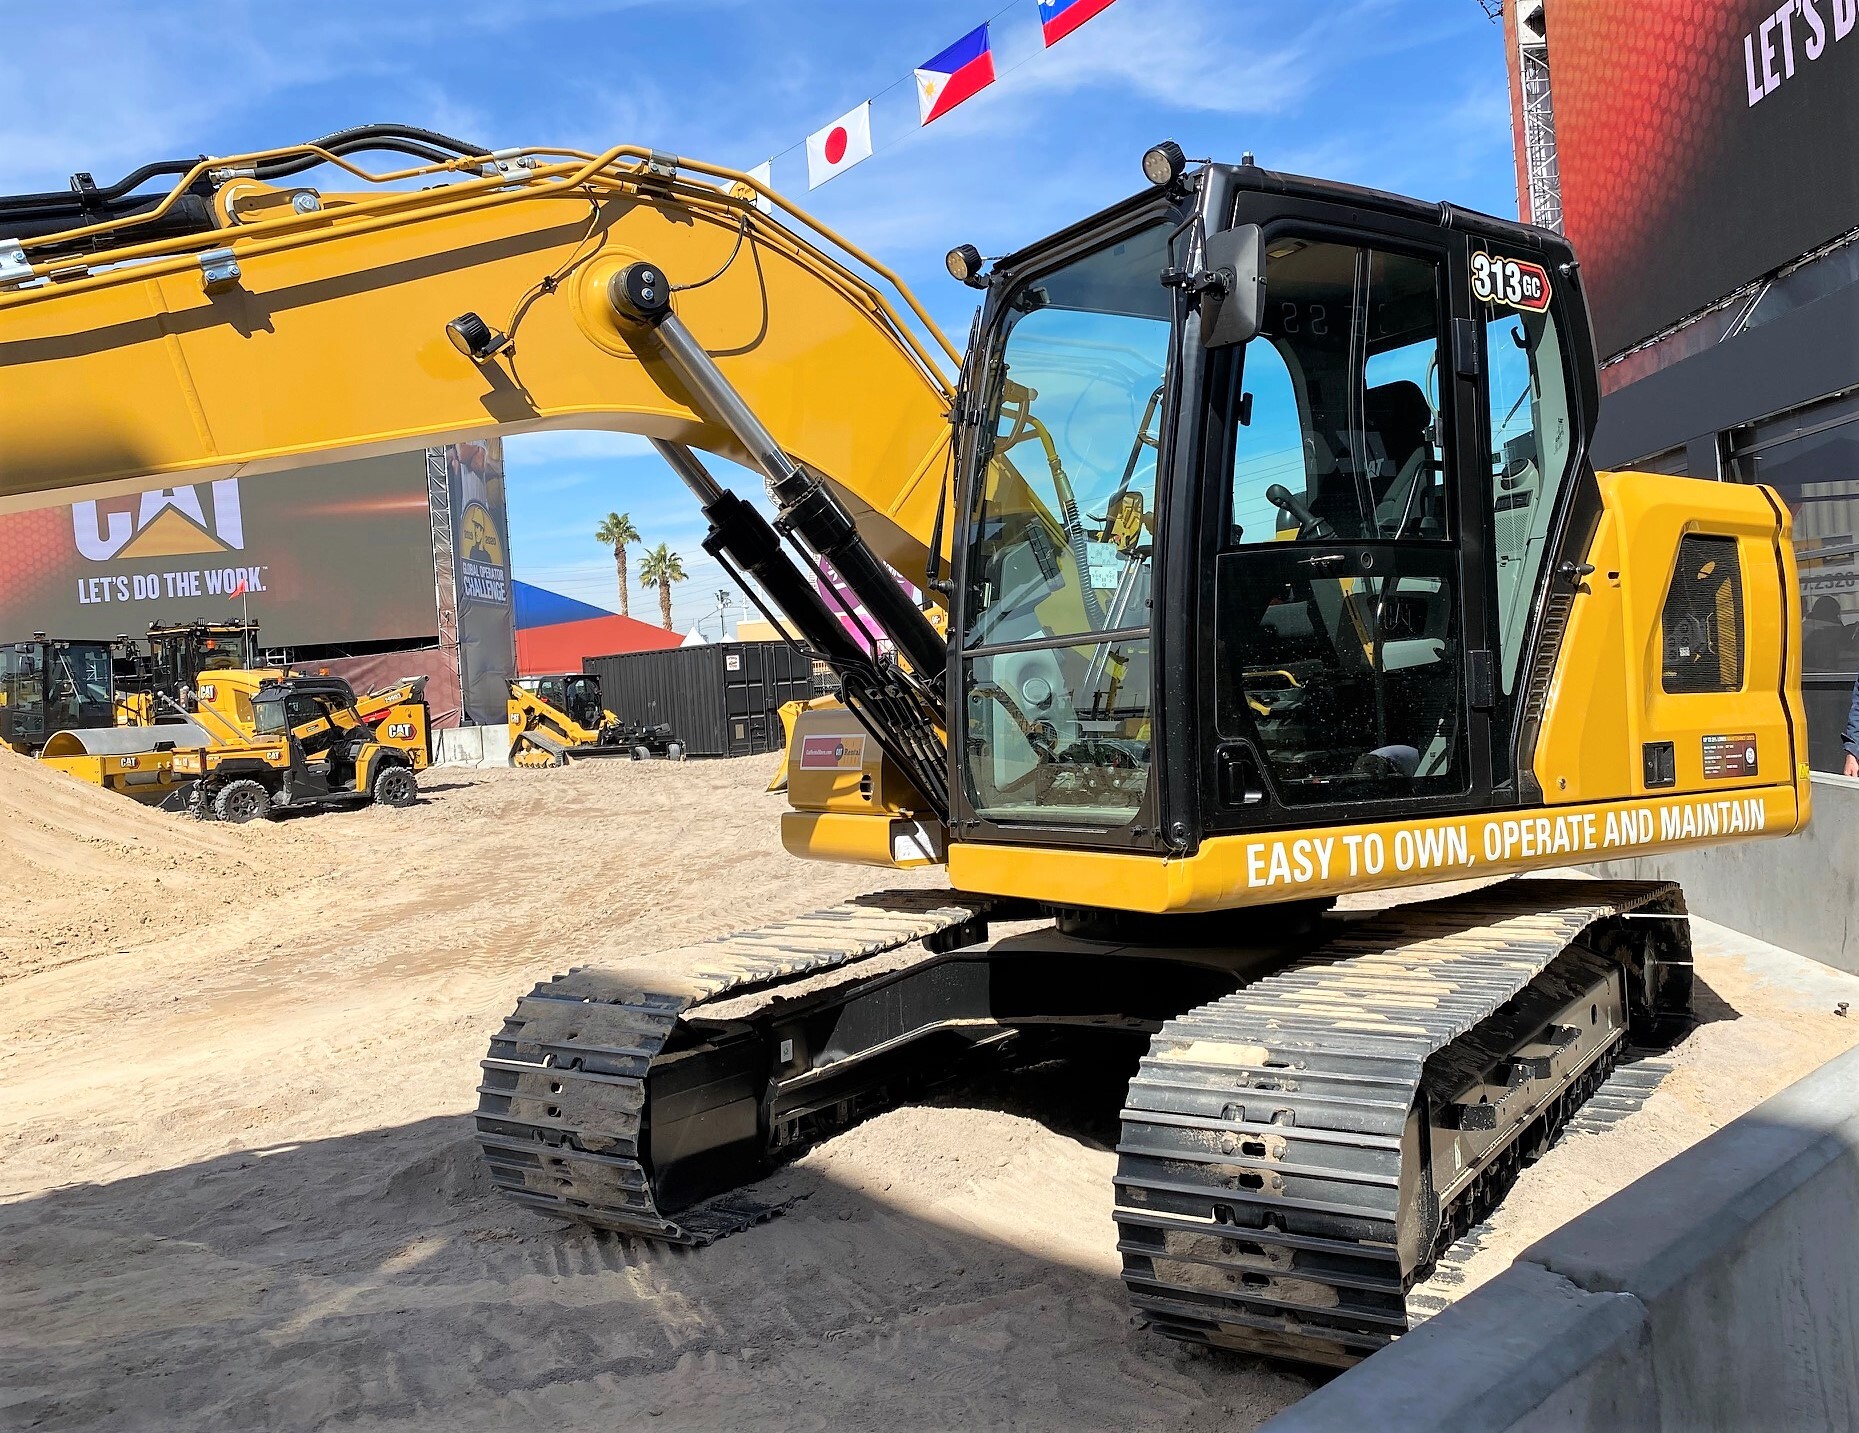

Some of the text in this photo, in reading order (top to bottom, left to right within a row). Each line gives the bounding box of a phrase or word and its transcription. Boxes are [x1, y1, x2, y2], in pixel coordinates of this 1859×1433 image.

[1744, 0, 1859, 107] LET'S D
[1473, 255, 1541, 302] 313 GC
[479, 566, 505, 581] OPERATOR
[78, 575, 130, 604] LET'S
[133, 573, 160, 600] DO
[163, 571, 202, 598] THE
[463, 576, 506, 601] CHALLENGE
[200, 685, 214, 700] CAT
[388, 724, 411, 738] CAT
[120, 757, 137, 767] CAT
[266, 752, 280, 760] CAT
[1246, 798, 1766, 887] EASY TO OWN, OPERATE AND MAINTAIN
